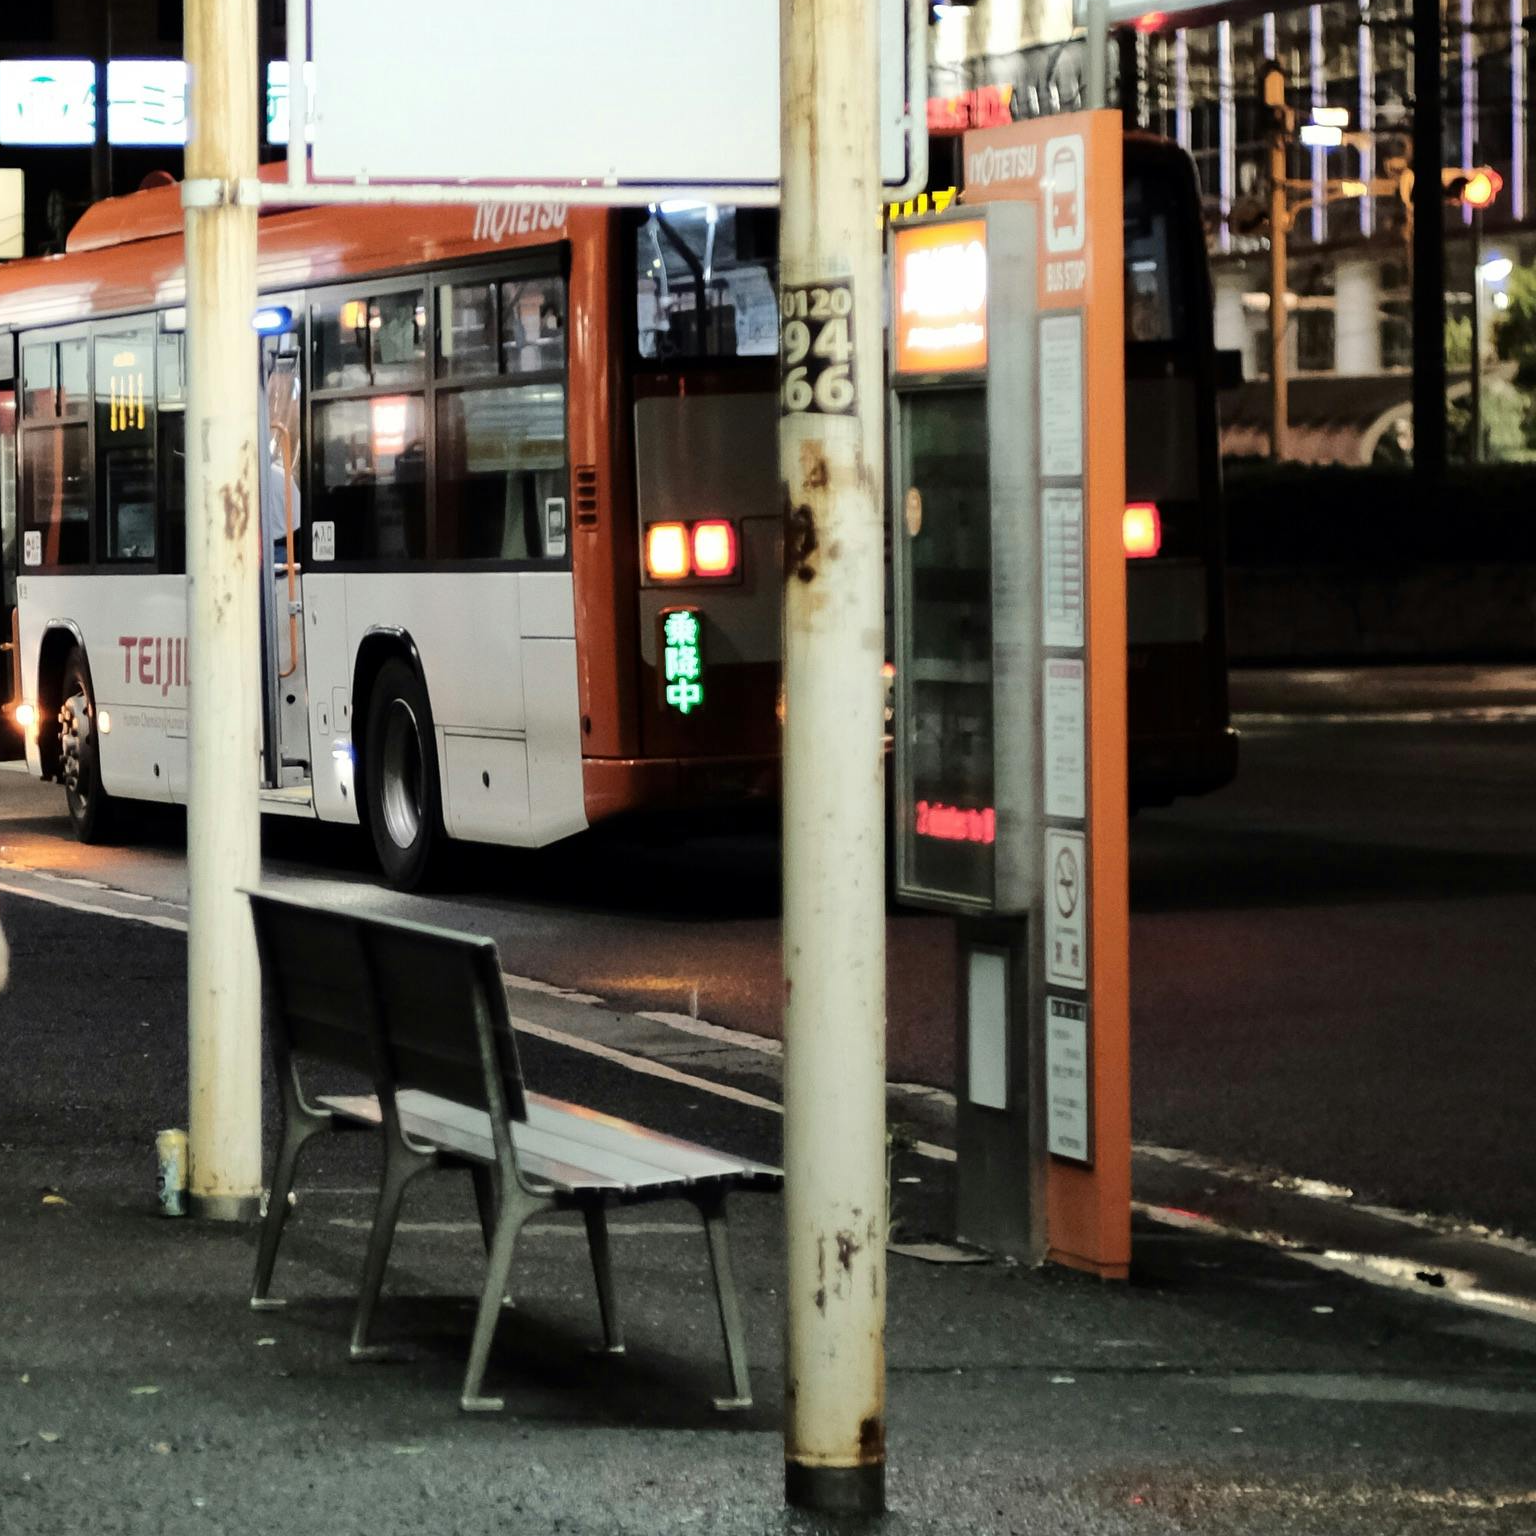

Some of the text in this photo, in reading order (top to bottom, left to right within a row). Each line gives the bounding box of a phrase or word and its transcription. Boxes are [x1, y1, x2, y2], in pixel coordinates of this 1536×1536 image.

[969, 144, 1037, 186] IYOTETSU
[1046, 259, 1085, 293] BUS STOP
[782, 288, 852, 320] 0120
